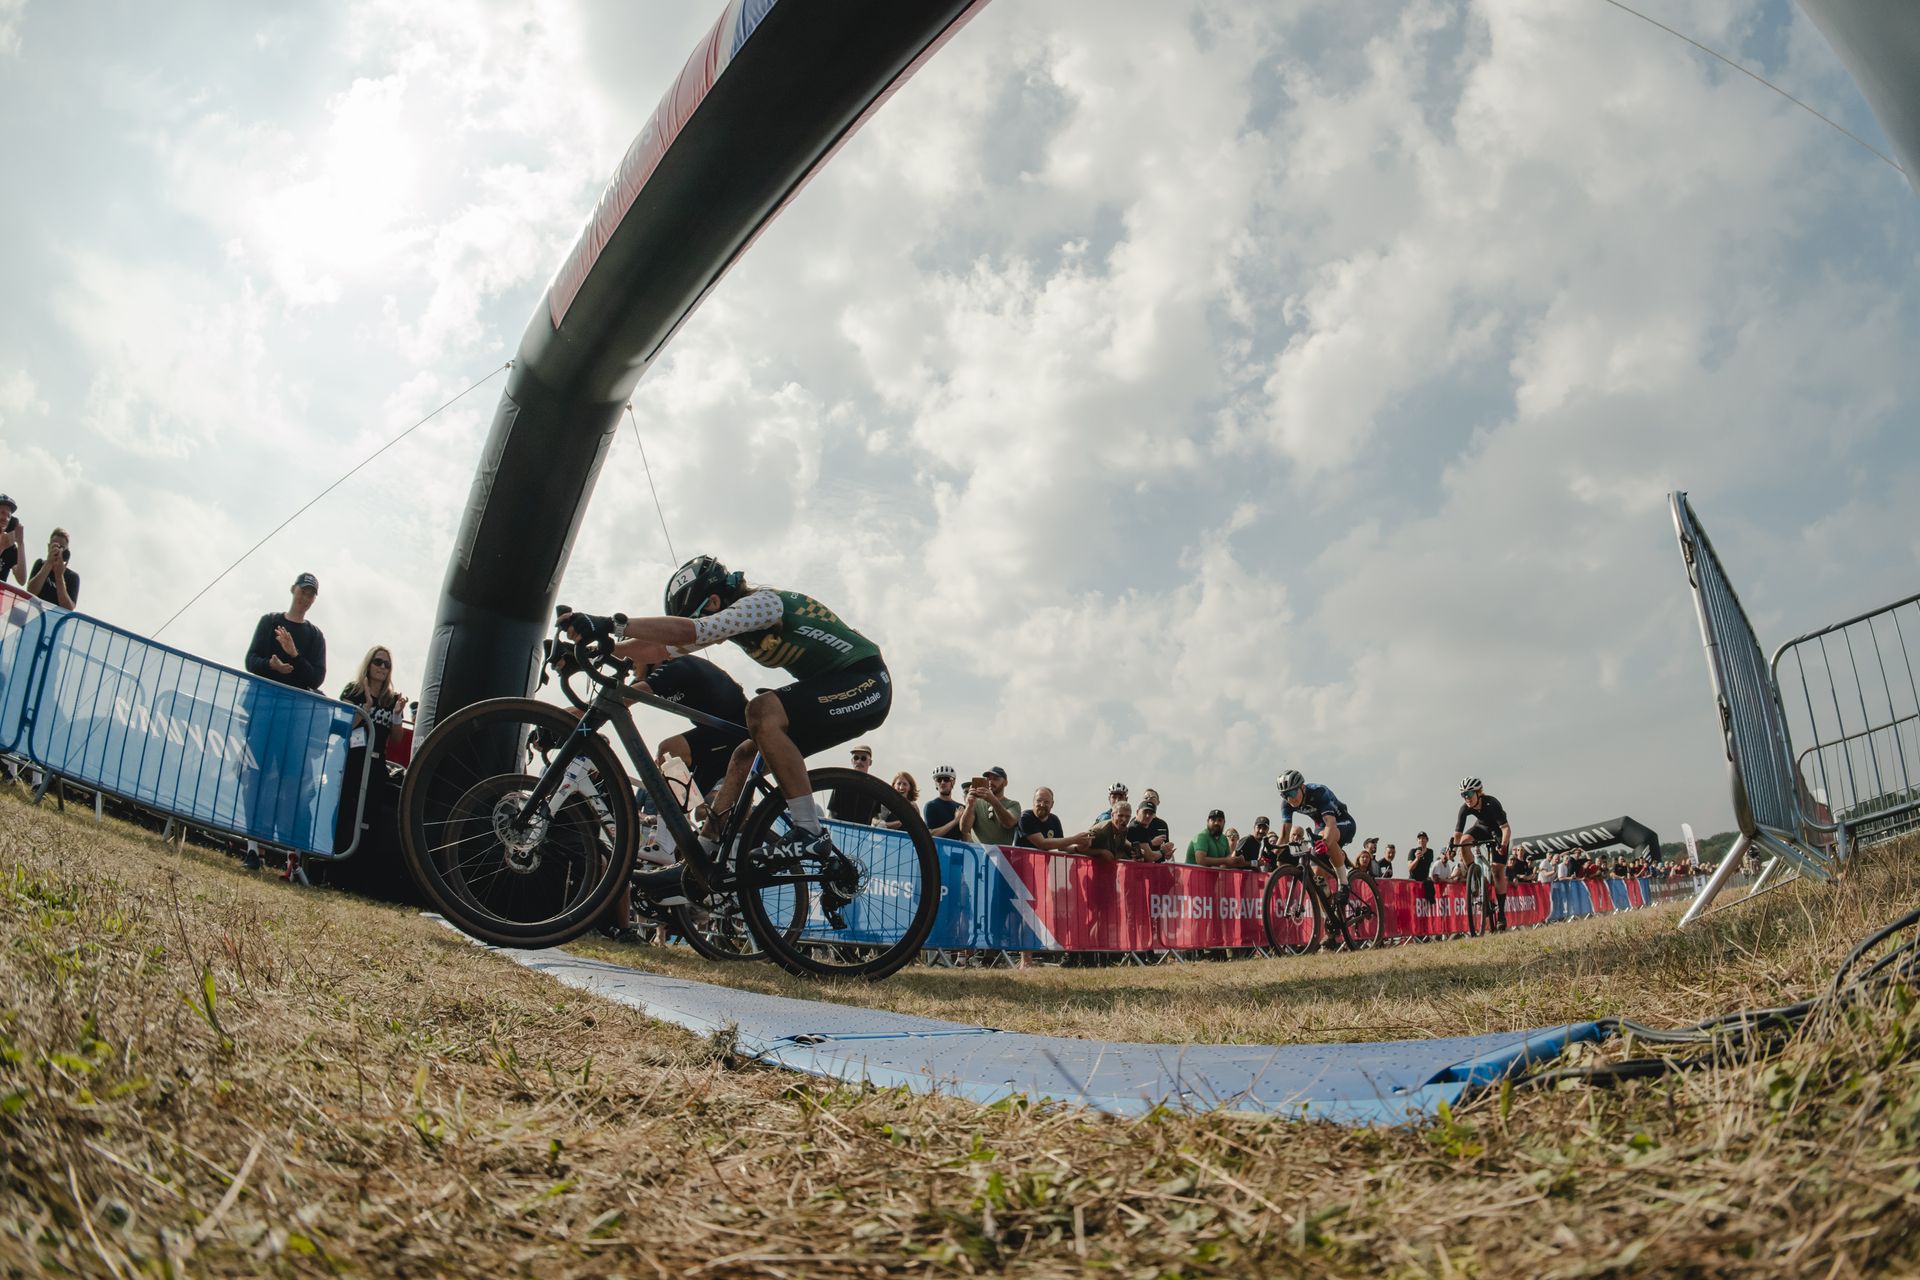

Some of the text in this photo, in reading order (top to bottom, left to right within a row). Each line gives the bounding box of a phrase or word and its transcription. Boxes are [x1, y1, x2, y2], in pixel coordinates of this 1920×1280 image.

[677, 575, 688, 588] 12
[794, 625, 854, 654] SRAM
[818, 678, 877, 703] SPECTRA
[829, 691, 881, 716] cannondale
[115, 697, 259, 770] CANYON
[762, 841, 803, 860] LAKE
[1521, 826, 1615, 855] CANYON
[1150, 894, 1213, 919] BRITISH
[1219, 897, 1263, 919] GRAVE
